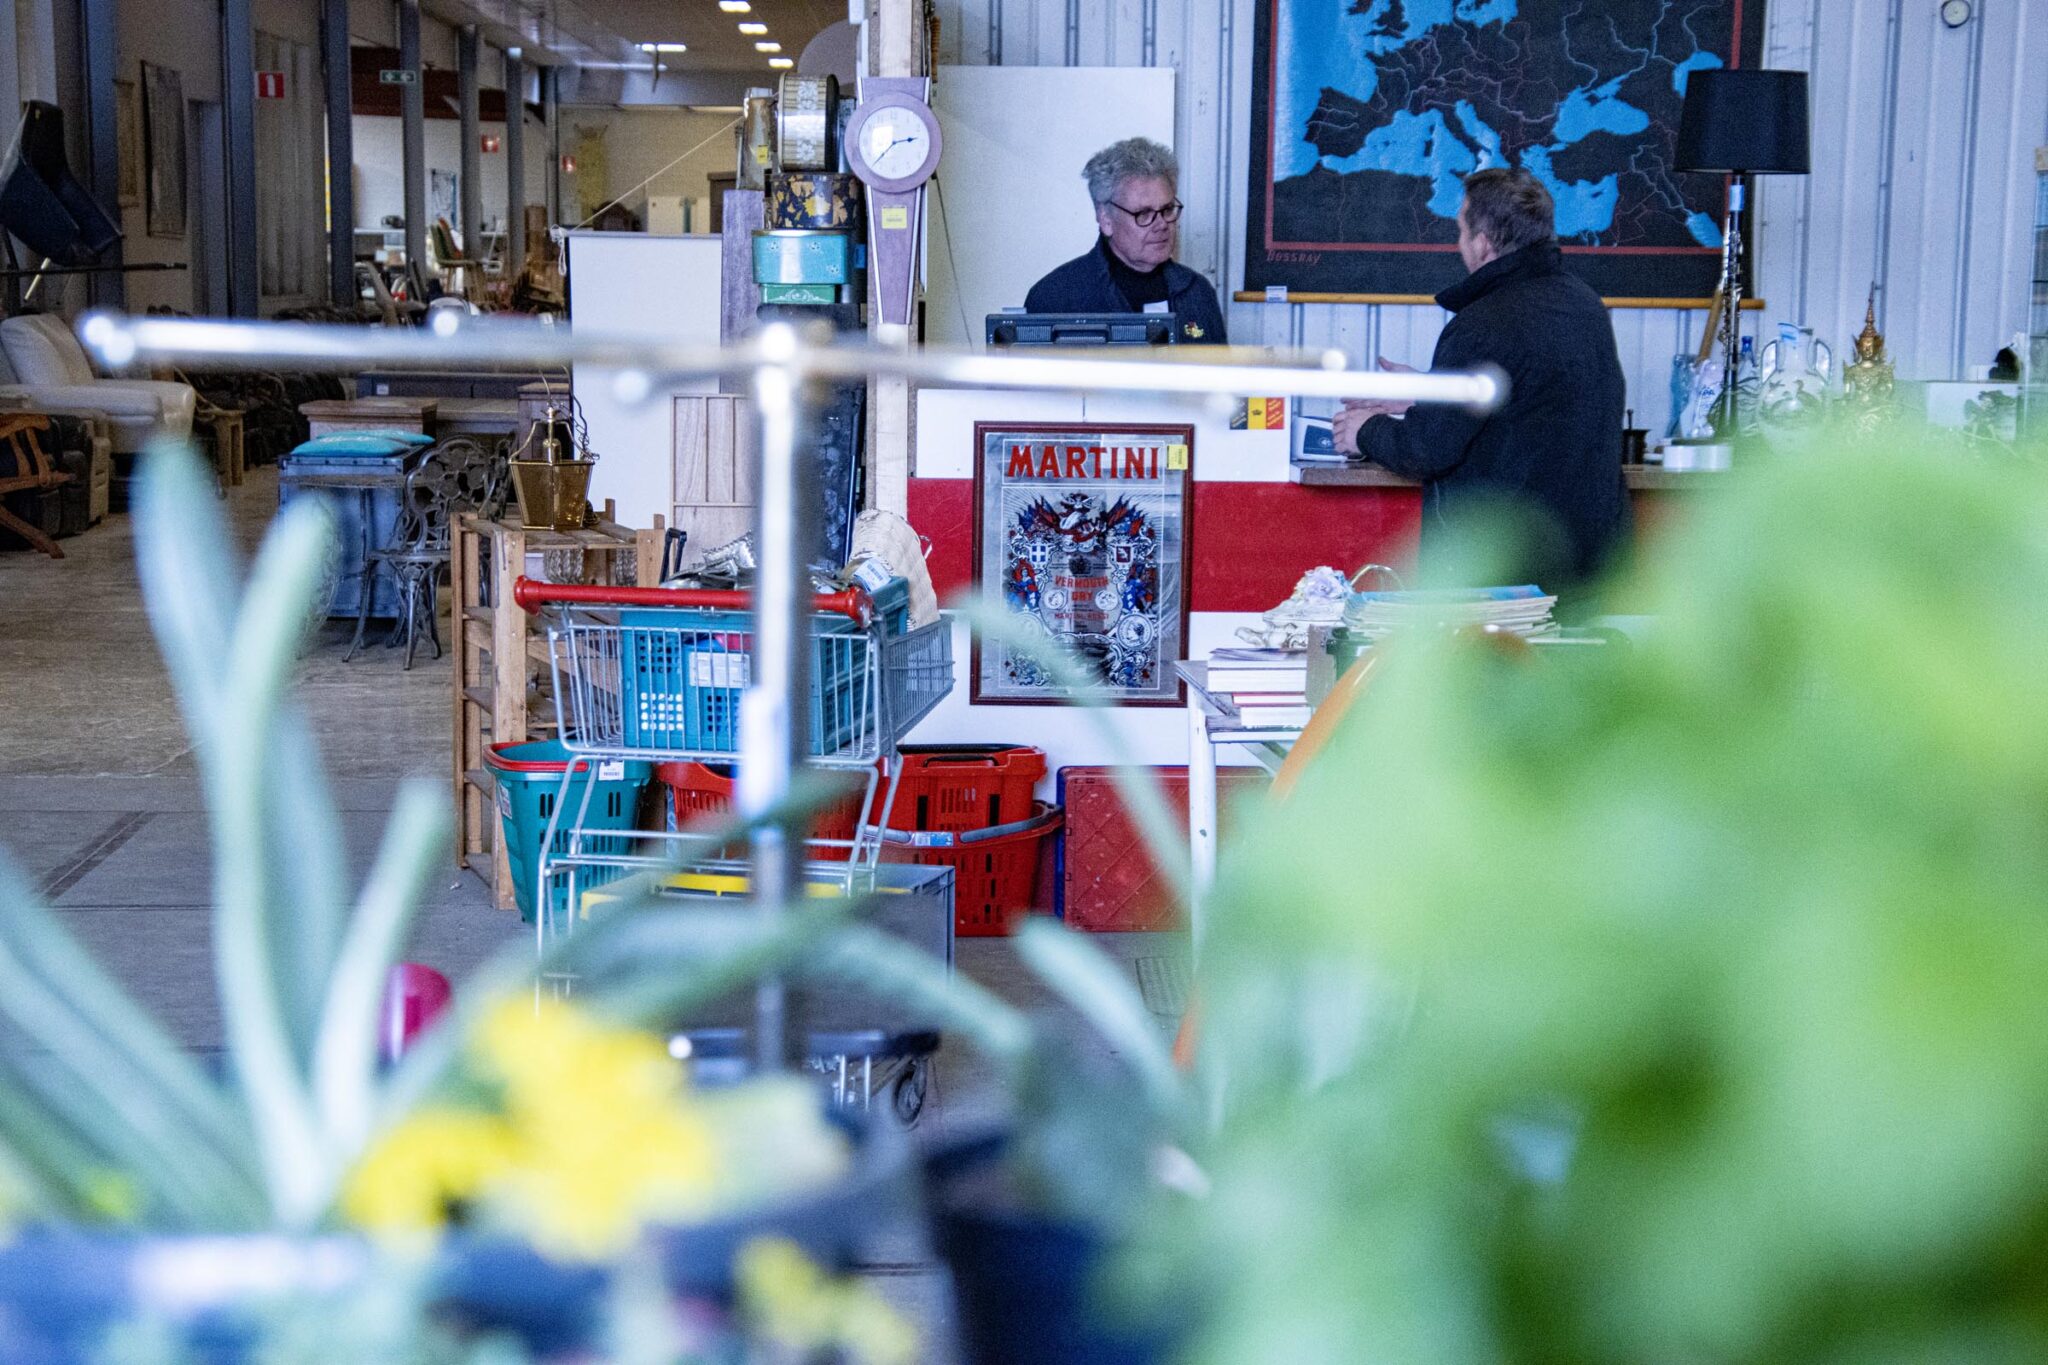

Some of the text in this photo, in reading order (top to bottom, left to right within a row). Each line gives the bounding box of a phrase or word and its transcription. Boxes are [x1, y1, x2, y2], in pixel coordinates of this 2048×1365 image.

[1007, 445, 1160, 480] MARTINI
[1055, 575, 1109, 588] VERMOUTH
[1072, 591, 1093, 601] DRY
